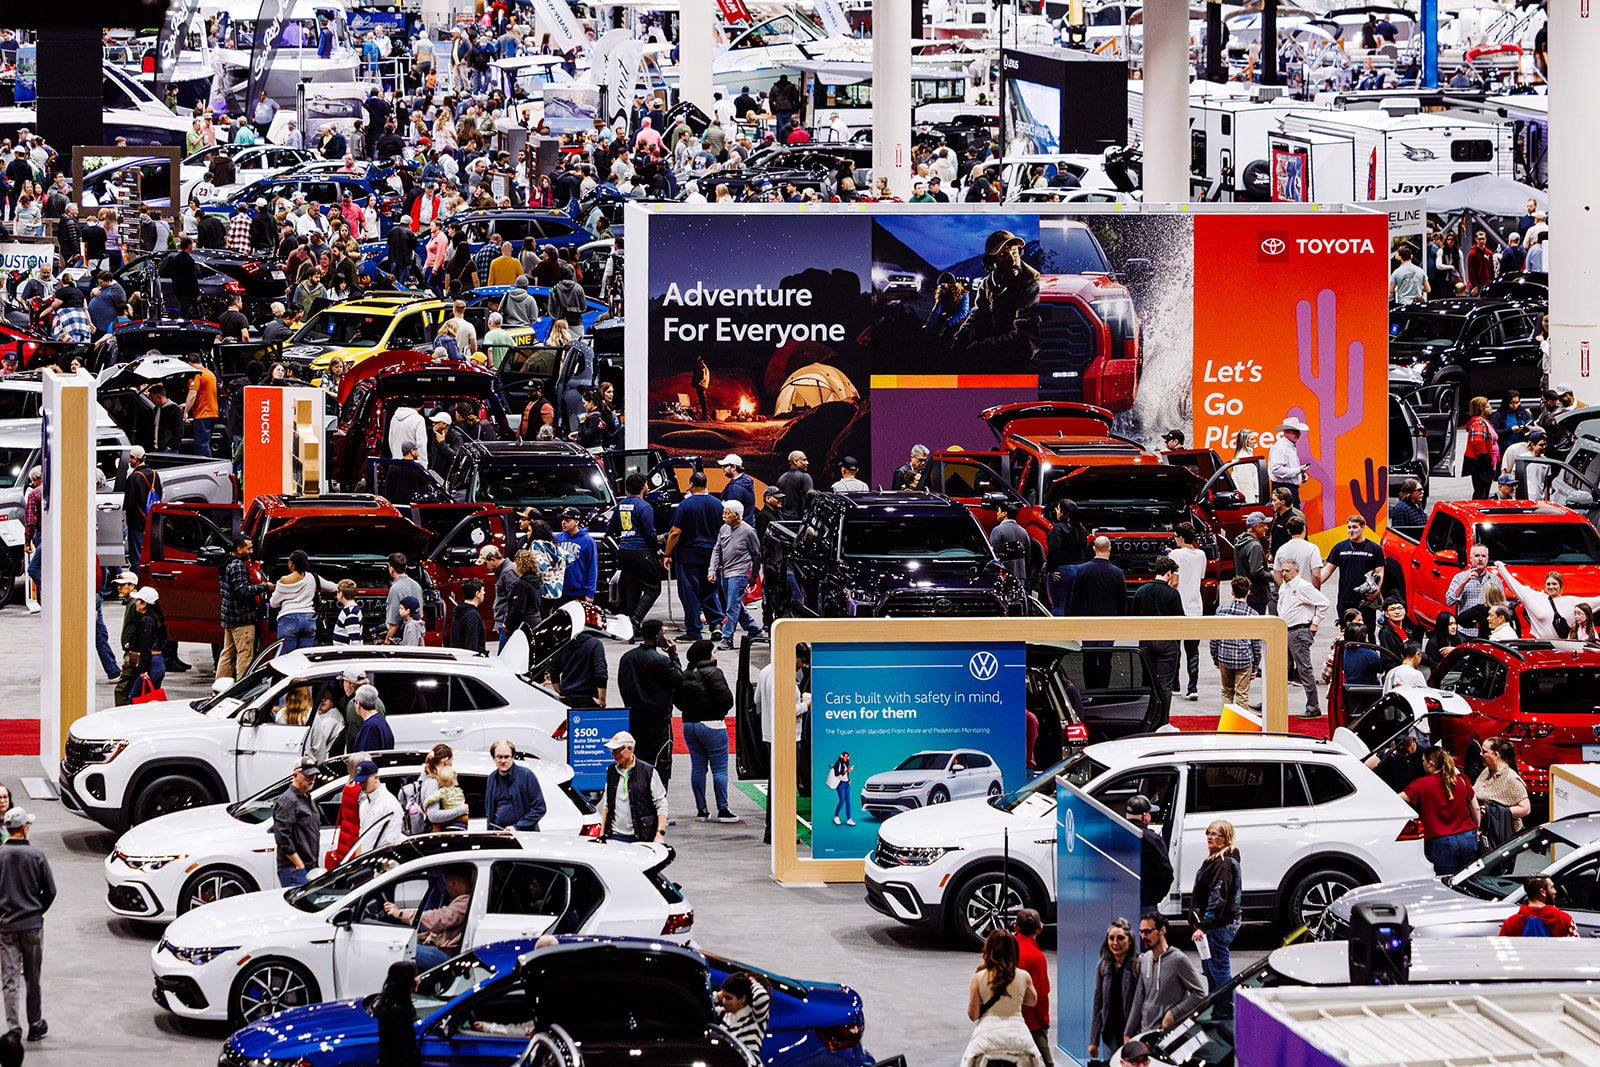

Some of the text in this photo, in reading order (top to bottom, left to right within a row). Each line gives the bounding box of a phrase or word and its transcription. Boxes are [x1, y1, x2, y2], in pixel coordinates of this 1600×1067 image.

[199, 188, 208, 196] 23
[1392, 182, 1445, 196] Jayc
[1296, 239, 1375, 254] TOYOTA
[663, 281, 812, 306] Adventure
[664, 317, 845, 348] For Everyone
[1203, 360, 1263, 383] Let’s
[1204, 392, 1243, 415] Go
[261, 399, 270, 444] TRUCKS
[1115, 541, 1165, 551] TOYOTA
[328, 599, 383, 609] TOOTA
[825, 690, 1003, 706] Cars built with safety in mind,
[825, 706, 917, 719] even for them
[574, 727, 598, 738] $500
